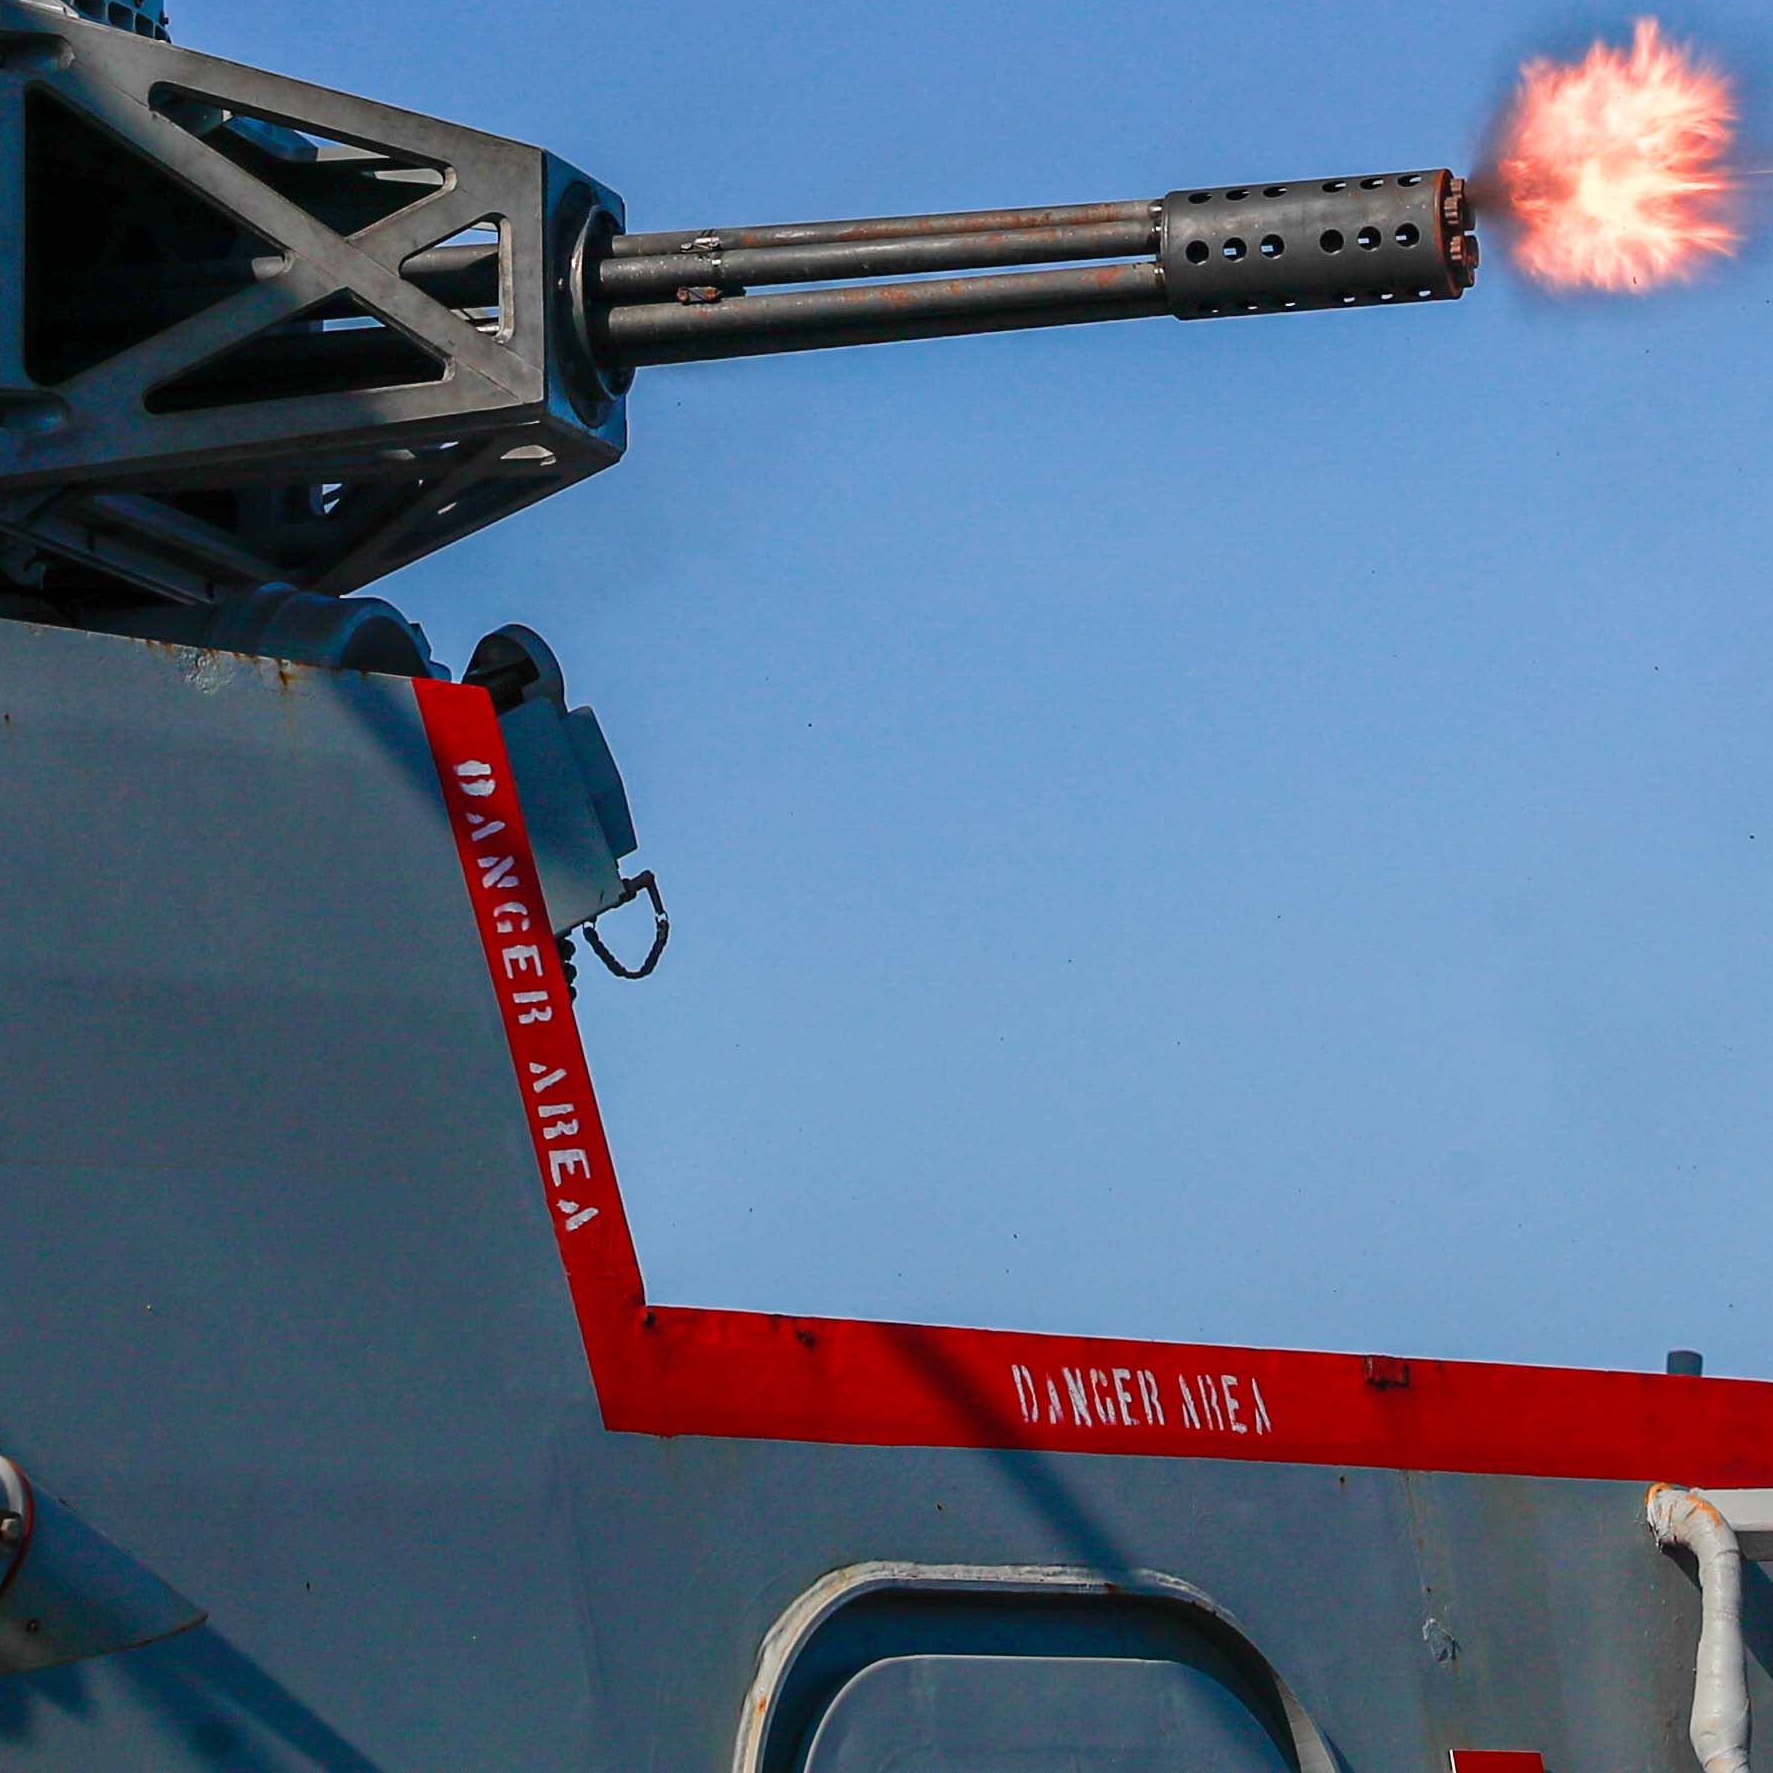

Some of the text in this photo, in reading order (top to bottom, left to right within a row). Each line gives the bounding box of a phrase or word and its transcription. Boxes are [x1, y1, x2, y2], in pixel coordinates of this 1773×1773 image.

[455, 759, 599, 1232] DANGER AREA
[1011, 1364, 1272, 1436] DANGER AREA
